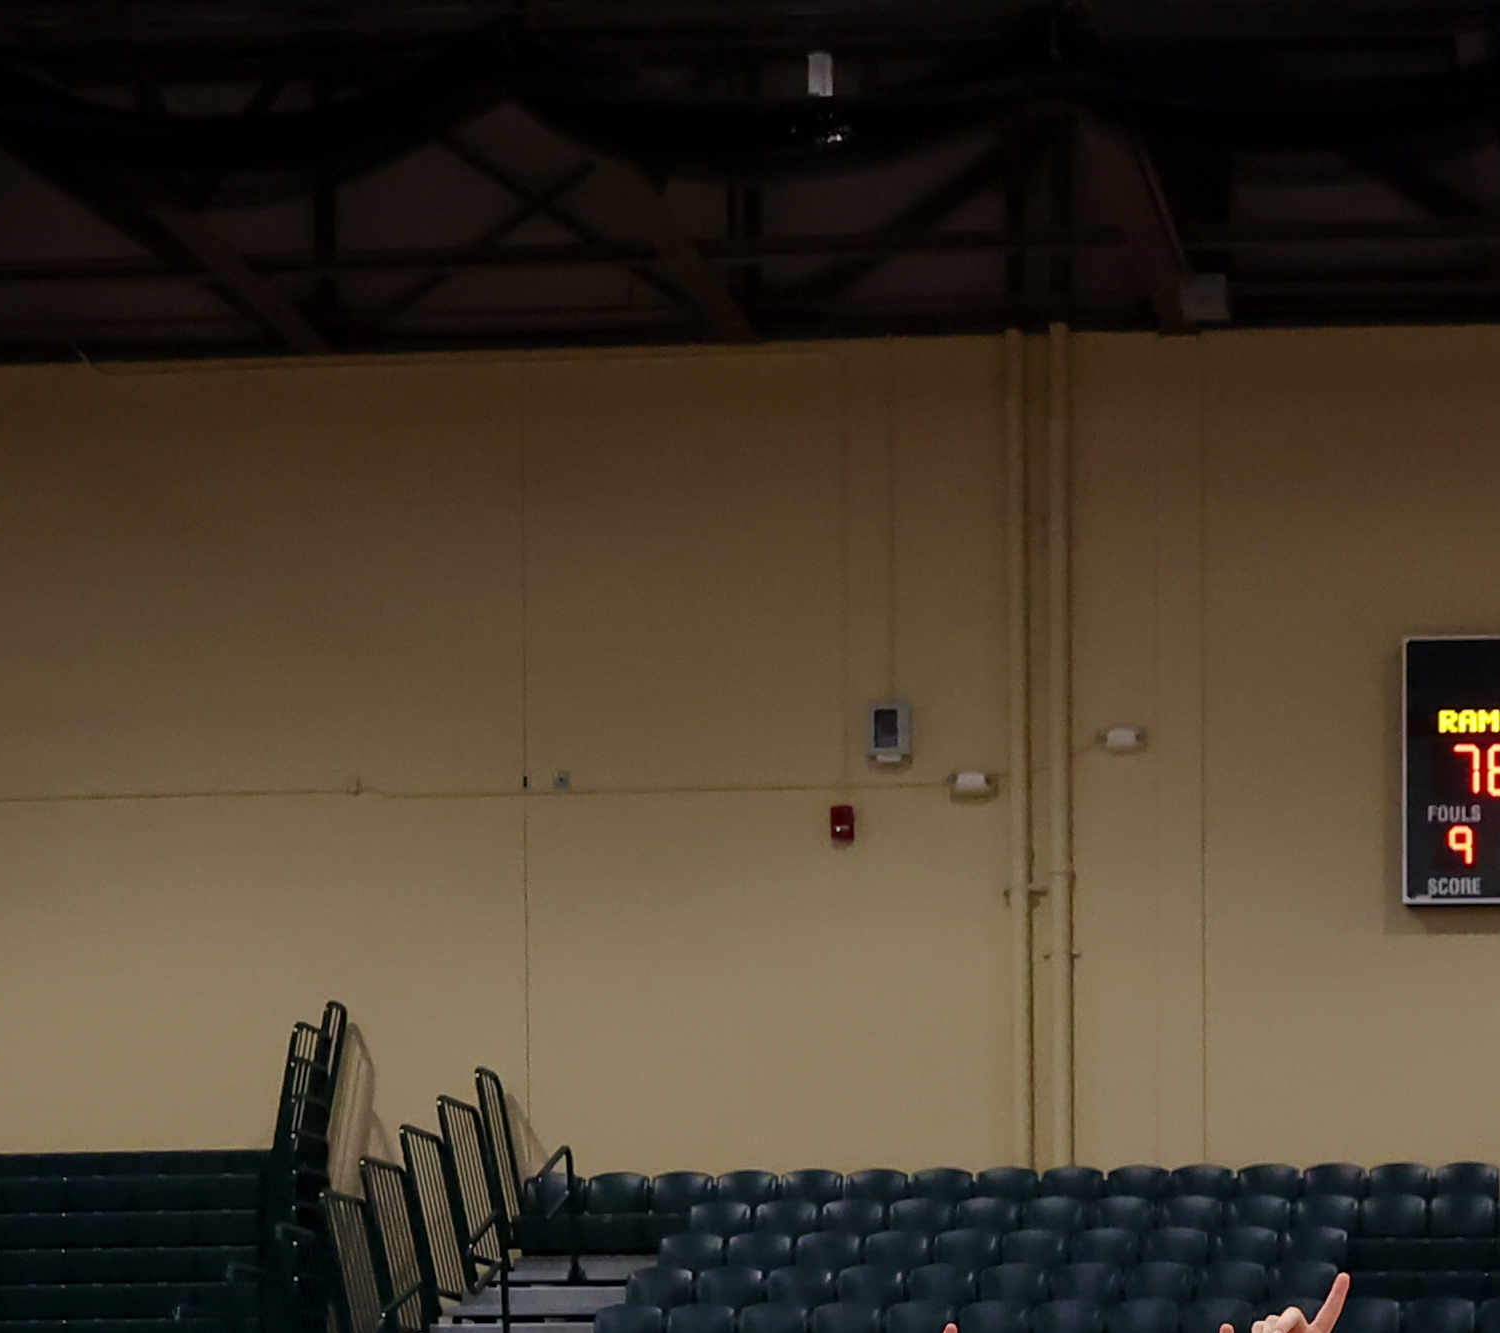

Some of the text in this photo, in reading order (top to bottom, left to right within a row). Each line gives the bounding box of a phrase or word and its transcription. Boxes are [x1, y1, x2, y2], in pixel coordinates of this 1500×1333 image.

[1427, 804, 1482, 822] FOULS
[1447, 825, 1474, 865] 9
[1427, 877, 1482, 895] SCORE
